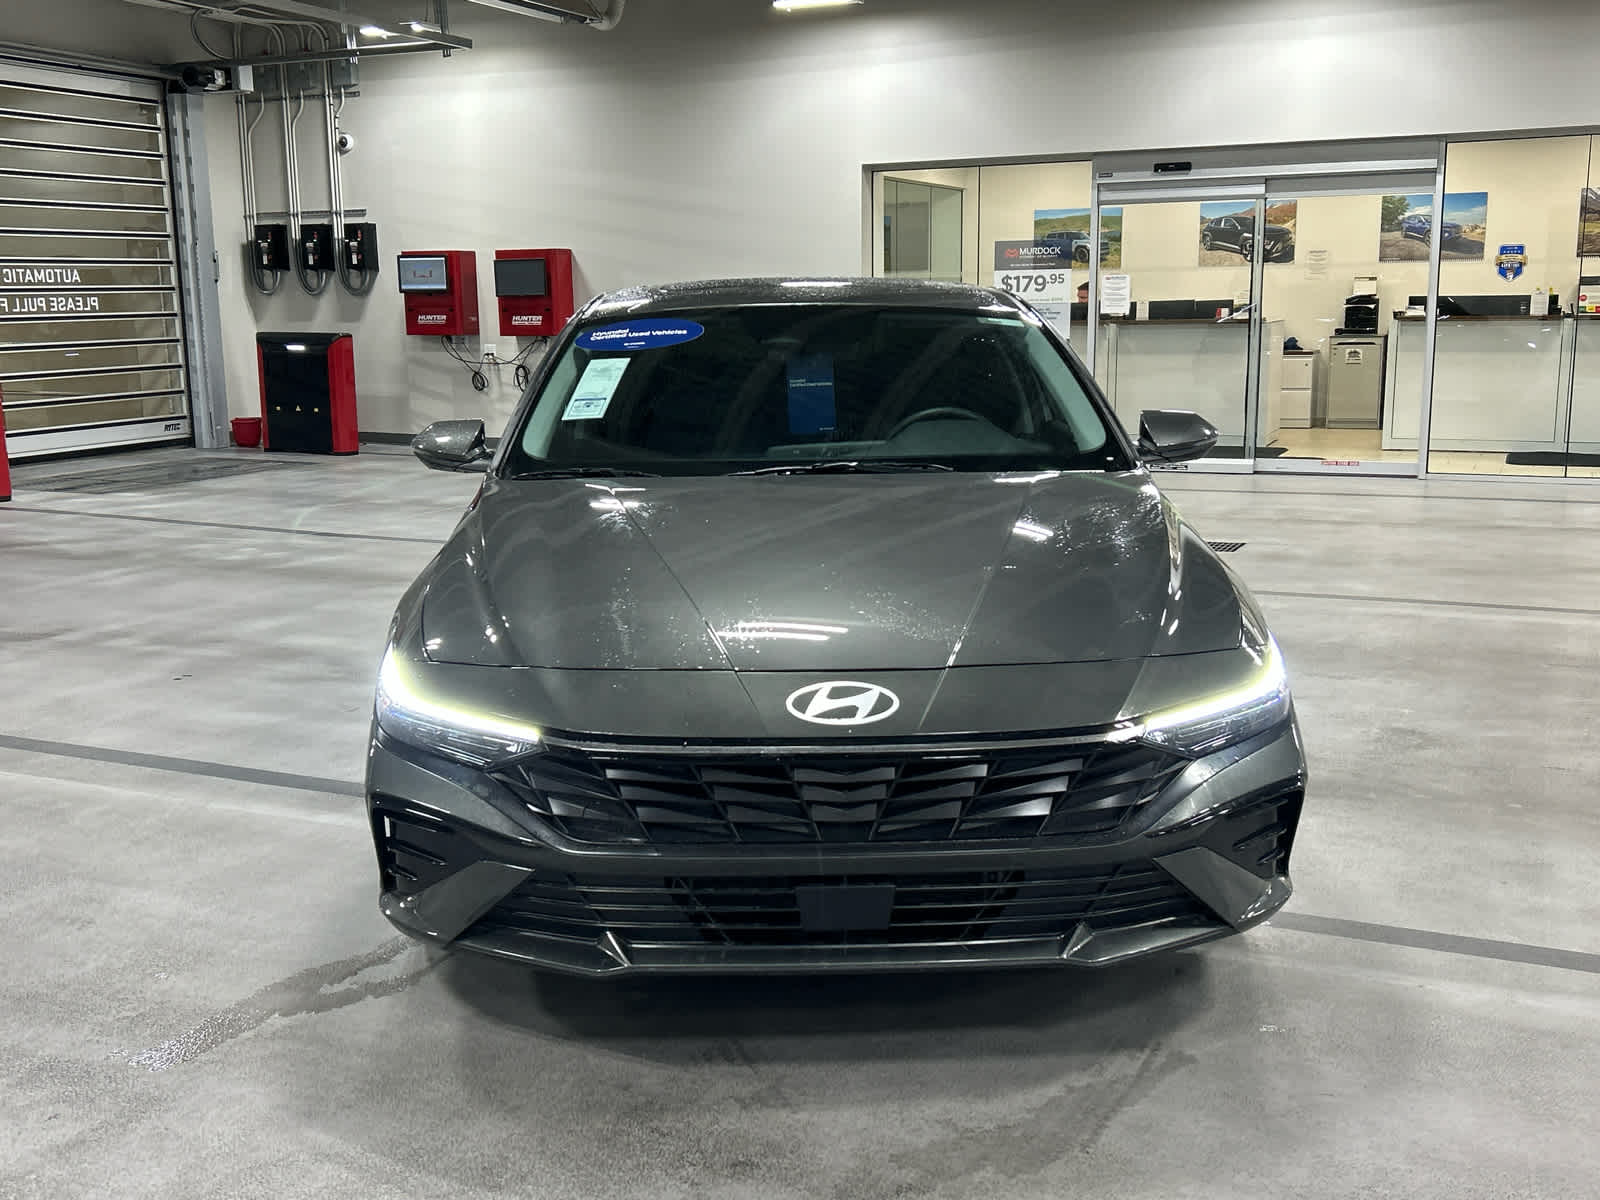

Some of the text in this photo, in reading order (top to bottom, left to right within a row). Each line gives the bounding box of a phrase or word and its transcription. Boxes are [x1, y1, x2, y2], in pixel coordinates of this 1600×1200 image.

[1019, 246, 1061, 255] MURDOCK
[1001, 273, 1065, 293] $179.95
[628, 330, 650, 338] Used
